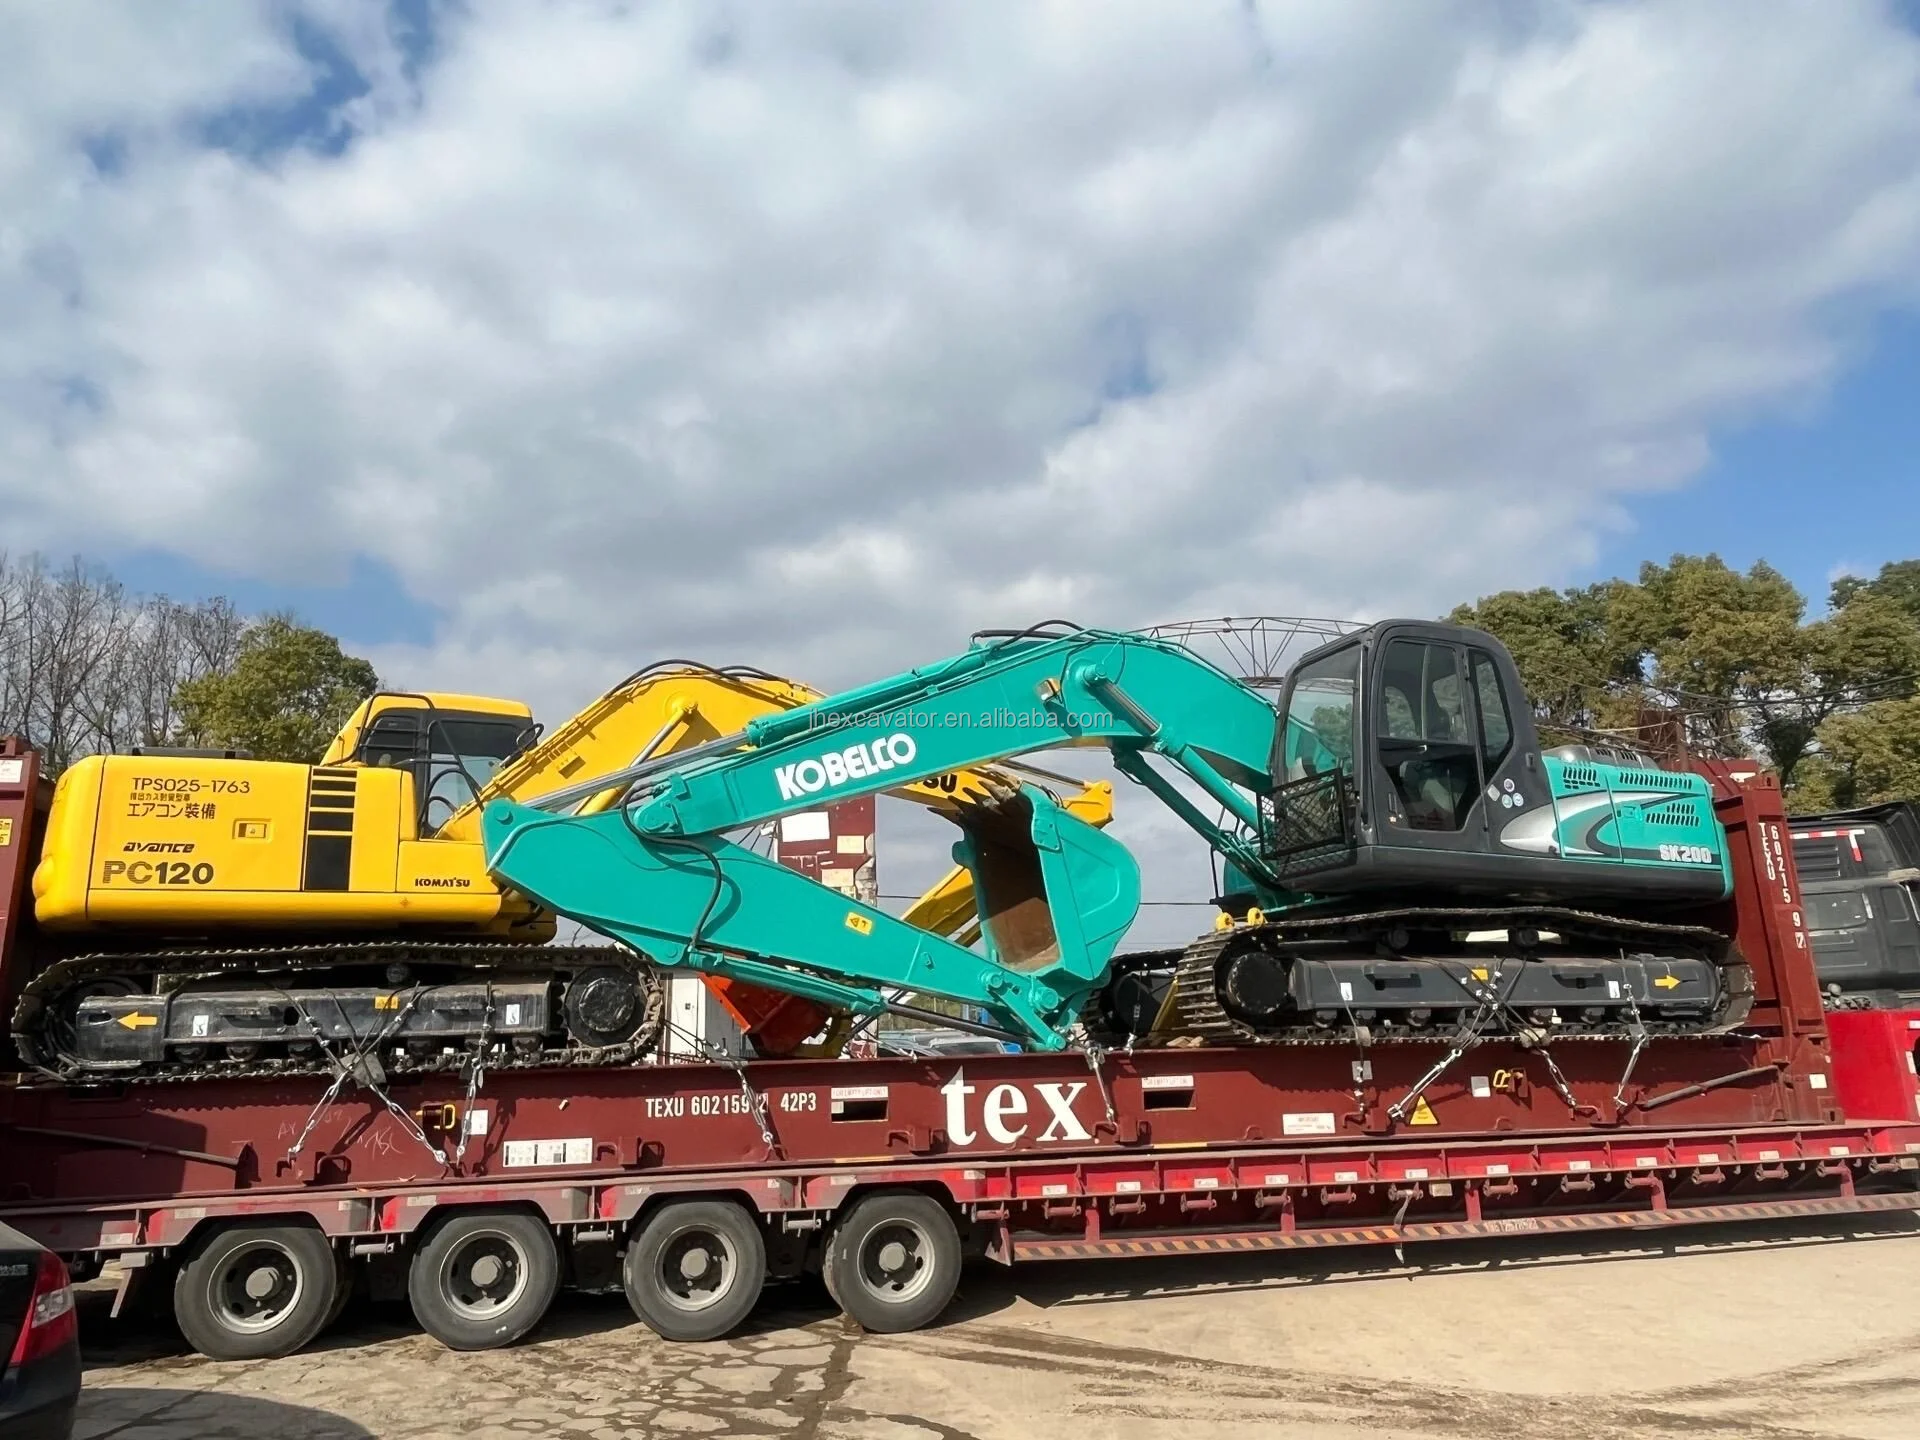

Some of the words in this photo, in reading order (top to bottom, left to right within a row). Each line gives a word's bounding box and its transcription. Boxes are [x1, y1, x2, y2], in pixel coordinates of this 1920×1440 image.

[774, 733, 917, 801] KOBELCO
[132, 778, 250, 793] TPS025-1763
[127, 803, 216, 819] エアコン装備
[123, 842, 195, 853] avance
[1659, 844, 1712, 864] SK200
[1758, 822, 1776, 881] TEXU
[102, 861, 214, 885] PC120
[414, 877, 471, 887] KOMATSU
[645, 1097, 685, 1118] TEXU
[691, 1094, 750, 1115] 602159
[780, 1093, 816, 1112] 42P3
[940, 1065, 1088, 1146] tex
